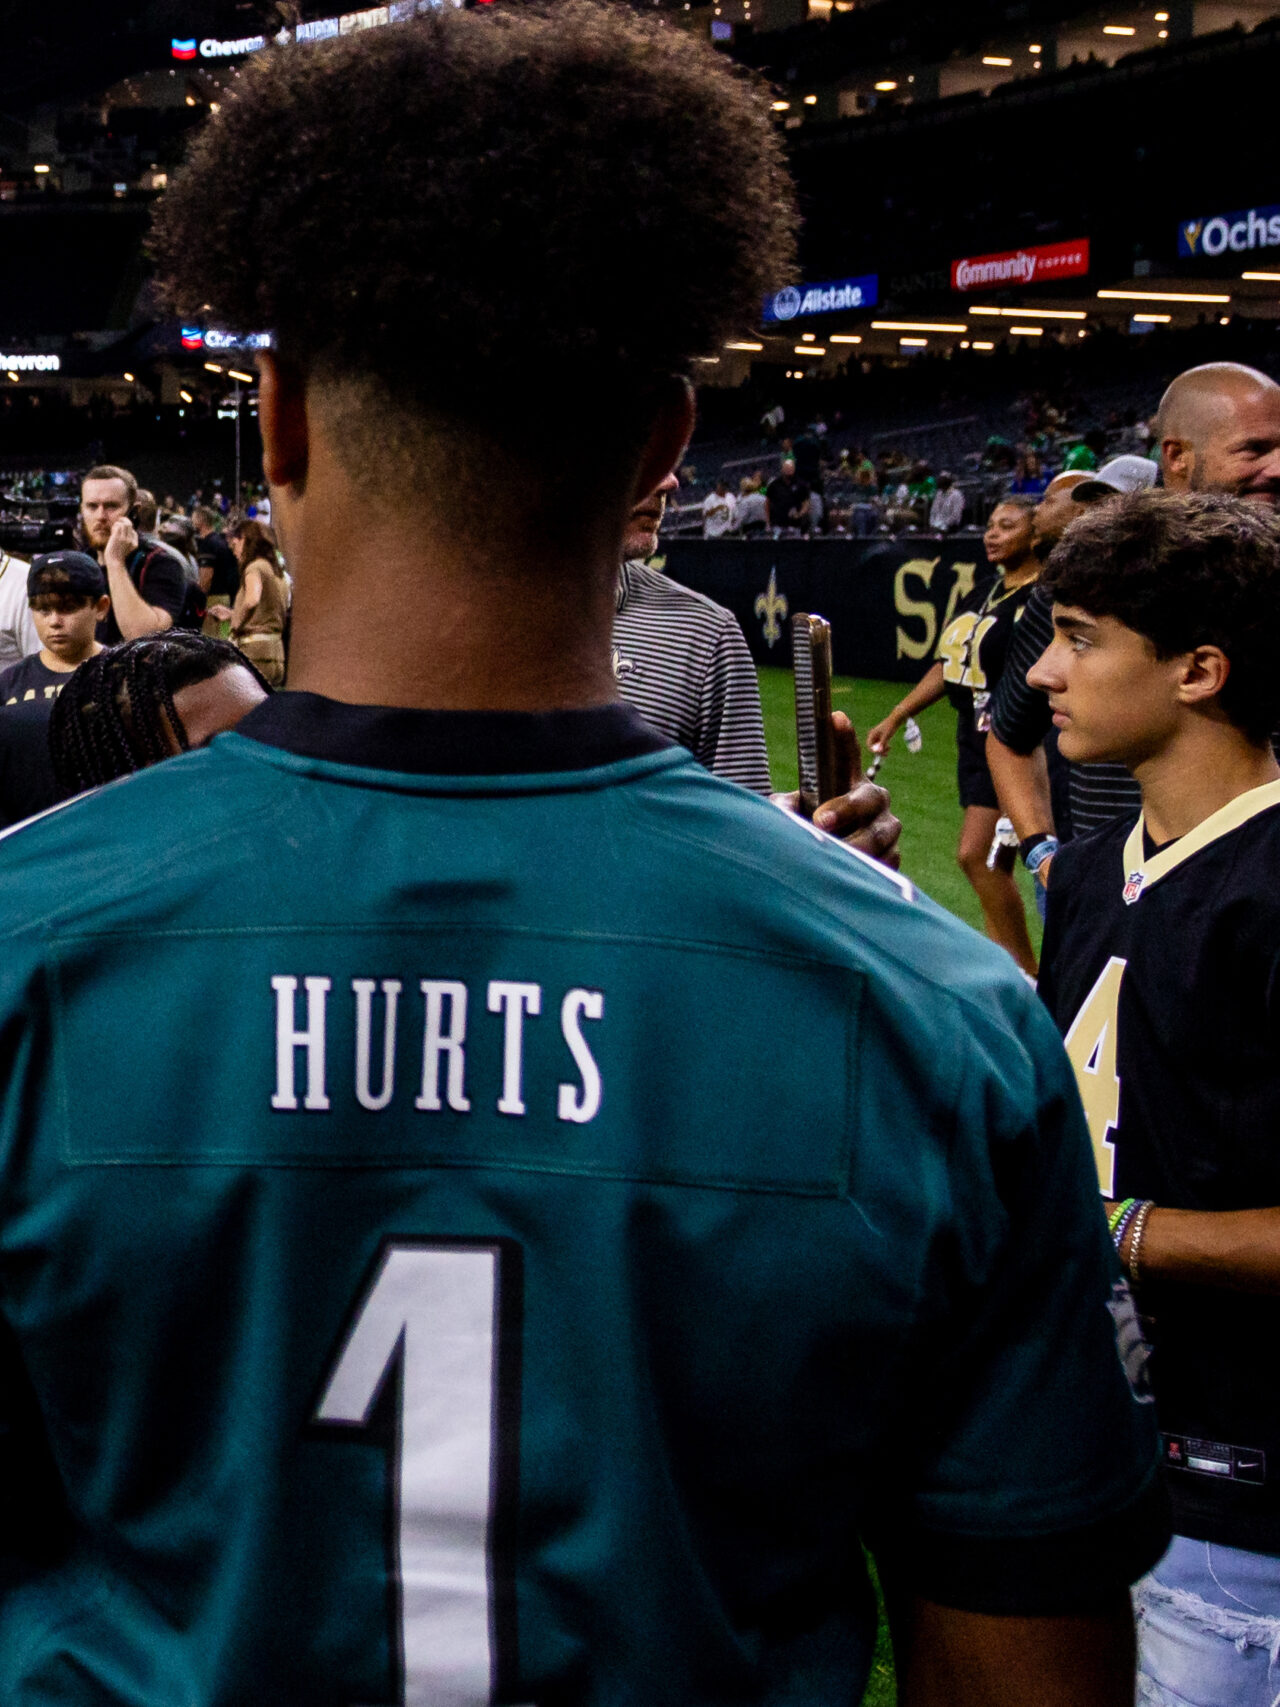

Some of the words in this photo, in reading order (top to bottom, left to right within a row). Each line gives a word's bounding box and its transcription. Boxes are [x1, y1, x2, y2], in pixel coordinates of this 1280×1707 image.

[956, 250, 1037, 292] Community
[1037, 252, 1082, 269] COFFEE
[1201, 208, 1280, 256] Ochs
[800, 283, 862, 314] Allstate
[939, 611, 998, 689] 41
[270, 975, 605, 1124] HURTS
[1062, 955, 1128, 1200] 4
[312, 1243, 505, 1707] 1
